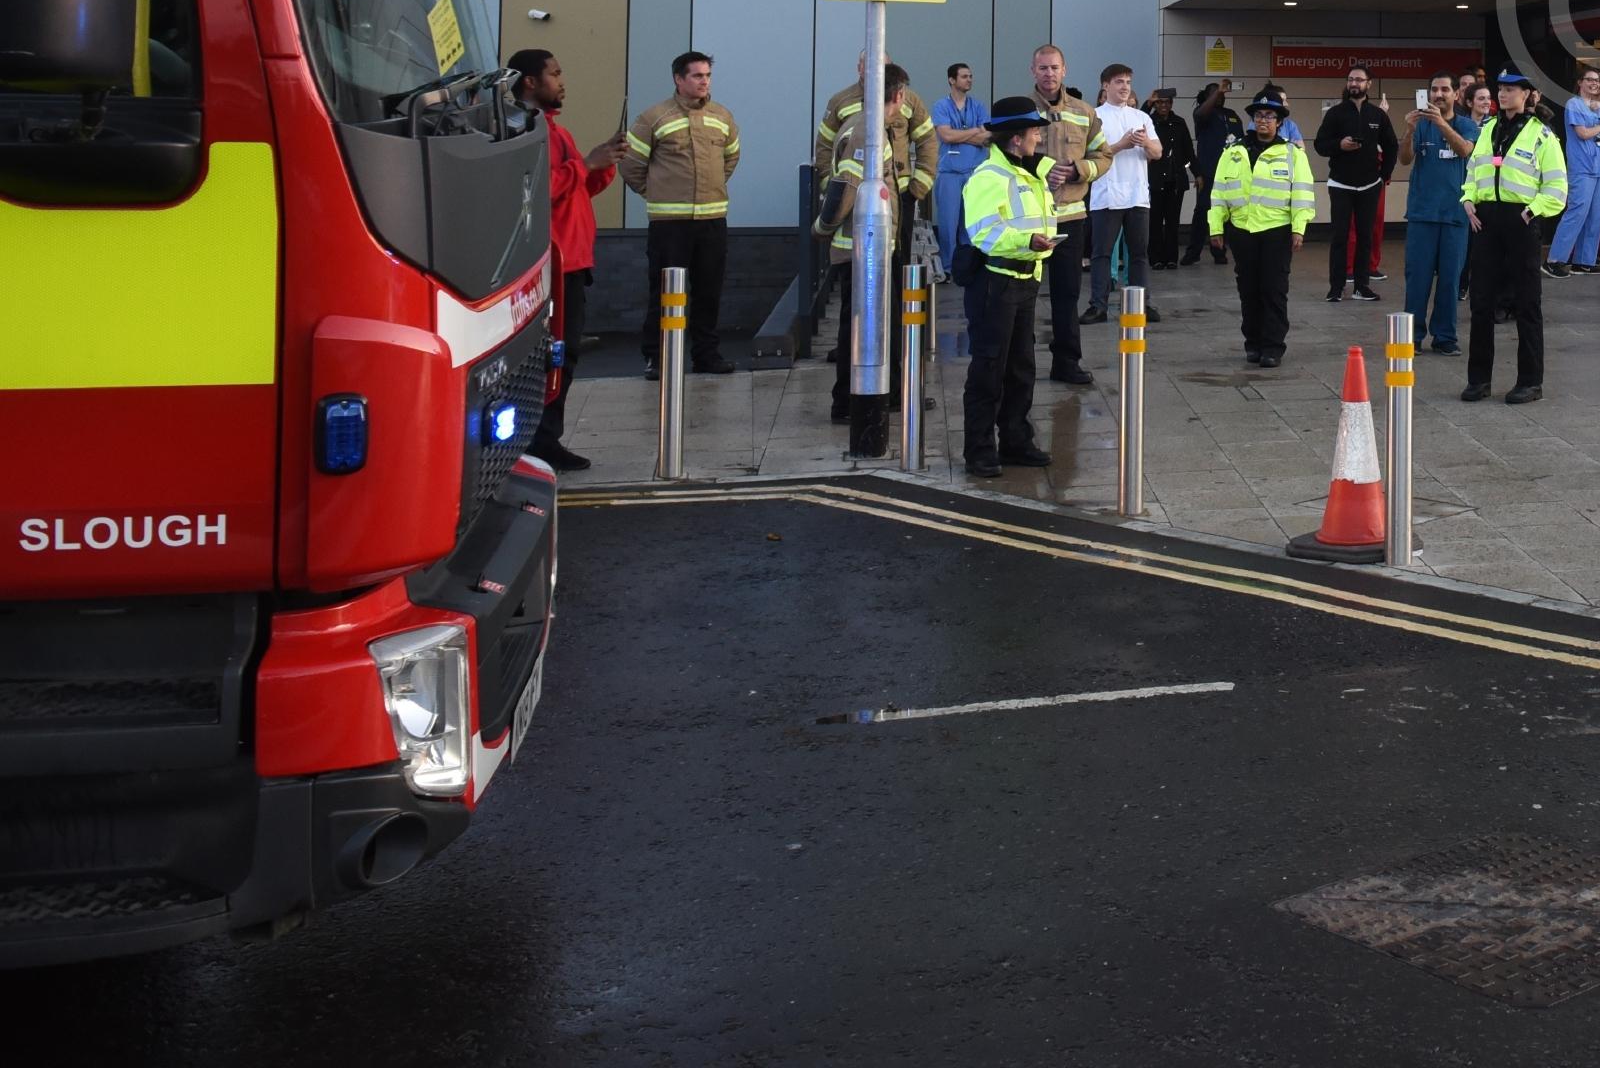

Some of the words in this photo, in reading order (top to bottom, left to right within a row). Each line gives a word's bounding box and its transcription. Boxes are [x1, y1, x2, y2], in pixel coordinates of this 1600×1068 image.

[1276, 55, 1344, 70] Emergency
[1348, 56, 1422, 69] Department
[19, 514, 226, 552] SLOUGH
